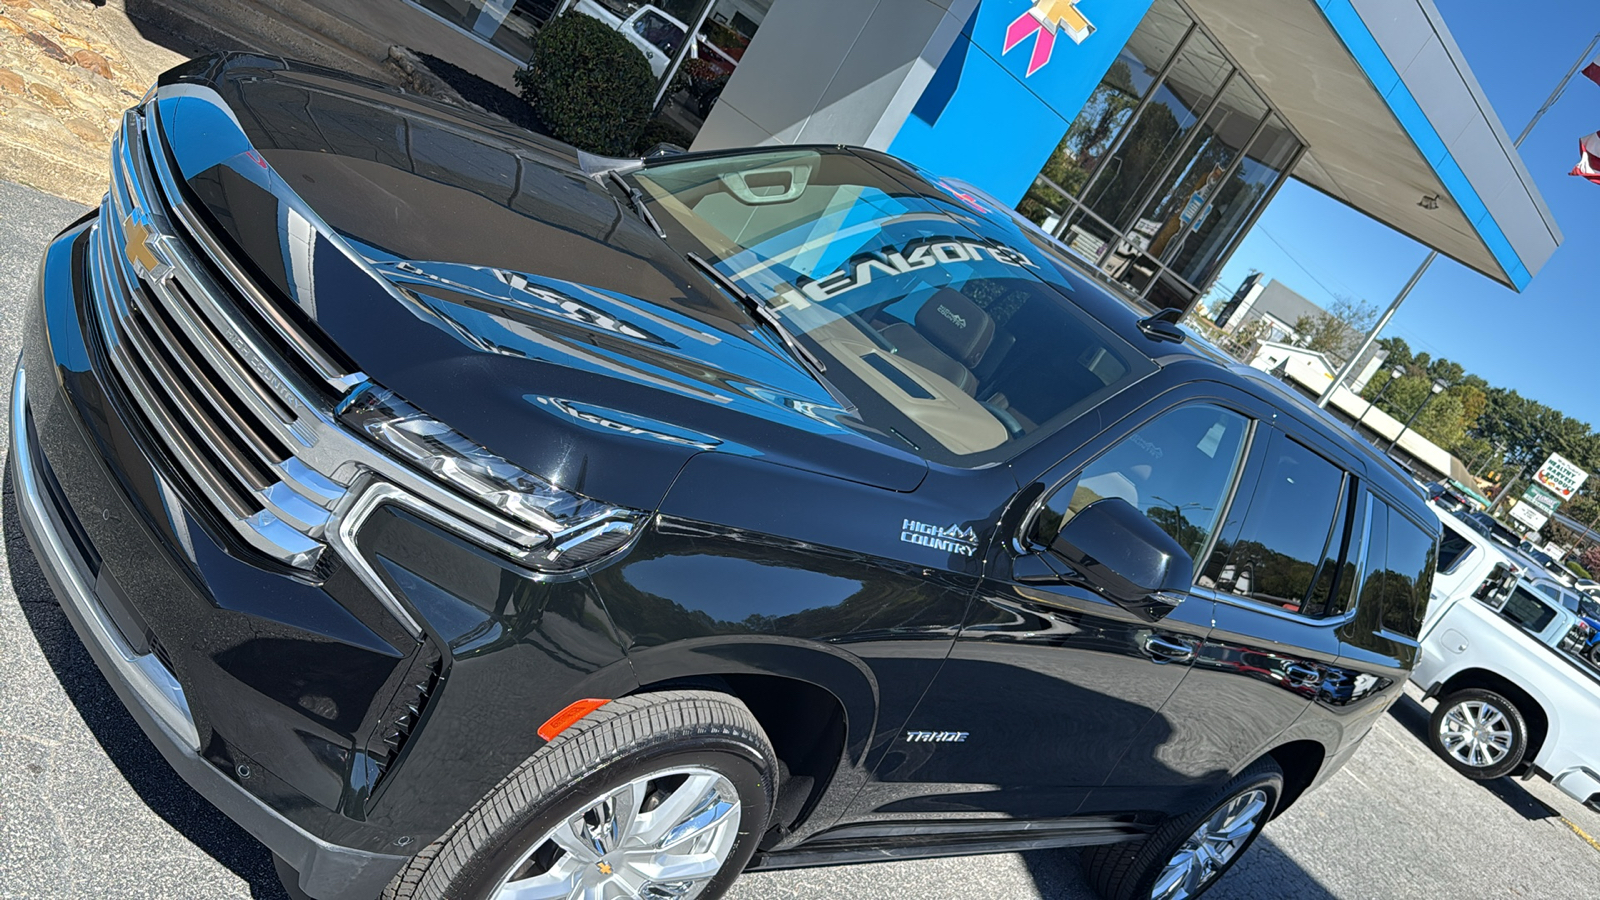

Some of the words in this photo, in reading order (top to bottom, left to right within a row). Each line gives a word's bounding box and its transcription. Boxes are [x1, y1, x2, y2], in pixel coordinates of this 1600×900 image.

[251, 354, 303, 408] COUNTRY
[1547, 466, 1576, 486] HARVEST
[1548, 459, 1576, 478] HEALTHY
[1545, 472, 1575, 492] PRODUCE
[902, 518, 944, 537] HIGH
[901, 531, 977, 556] COUNTRY
[906, 731, 969, 742] TAHOE
